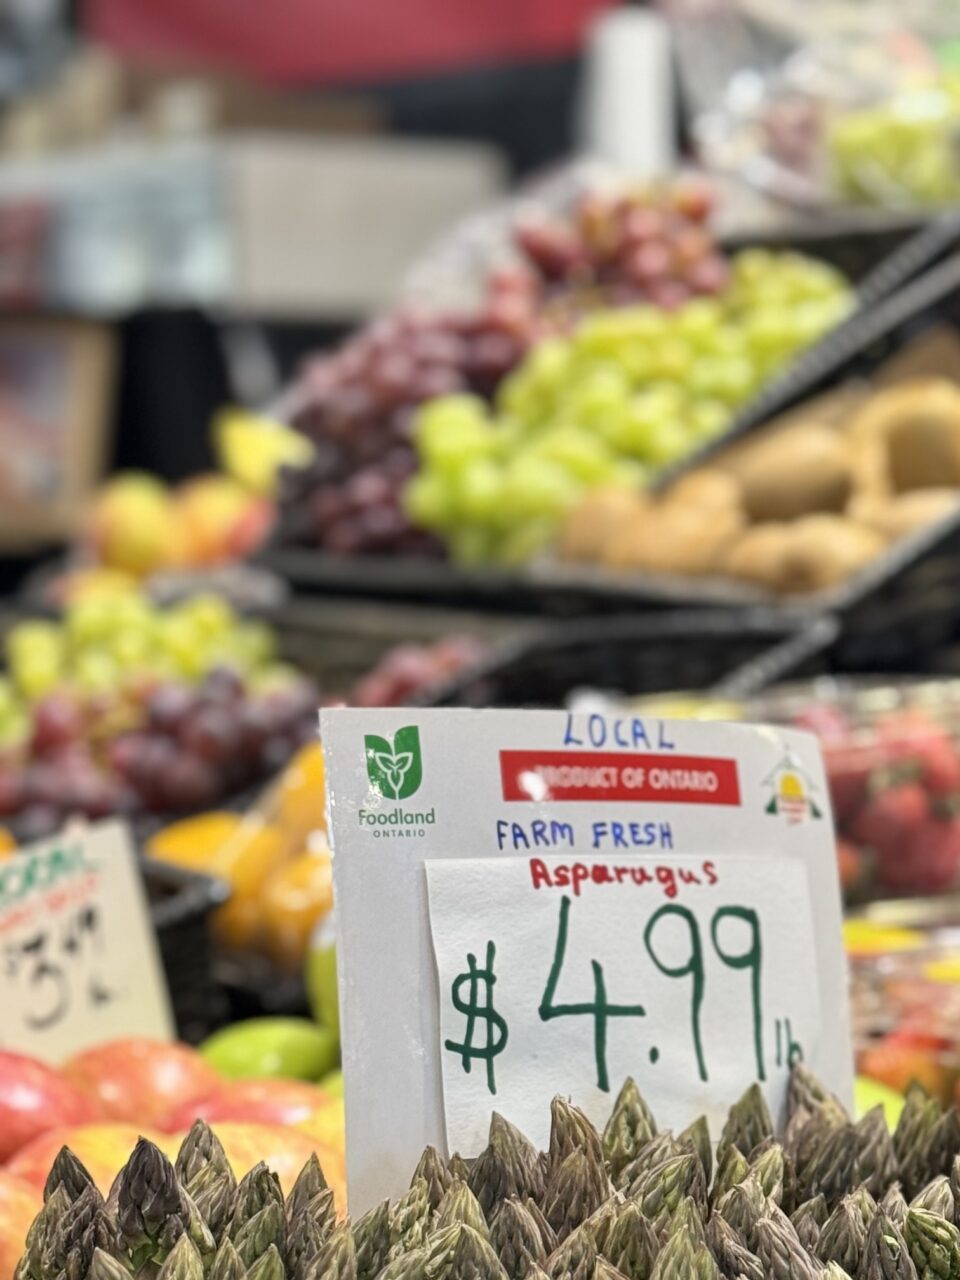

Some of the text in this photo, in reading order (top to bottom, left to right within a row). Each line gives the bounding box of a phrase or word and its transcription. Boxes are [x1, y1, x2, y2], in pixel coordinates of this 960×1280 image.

[562, 714, 675, 749] LOCAL
[621, 767, 645, 789] OF
[648, 769, 718, 792] ONTARIO
[358, 808, 436, 825] Foodland
[373, 829, 425, 838] ONTARIO
[497, 819, 674, 850] FARM FRESH
[774, 1018, 804, 1070] lb
